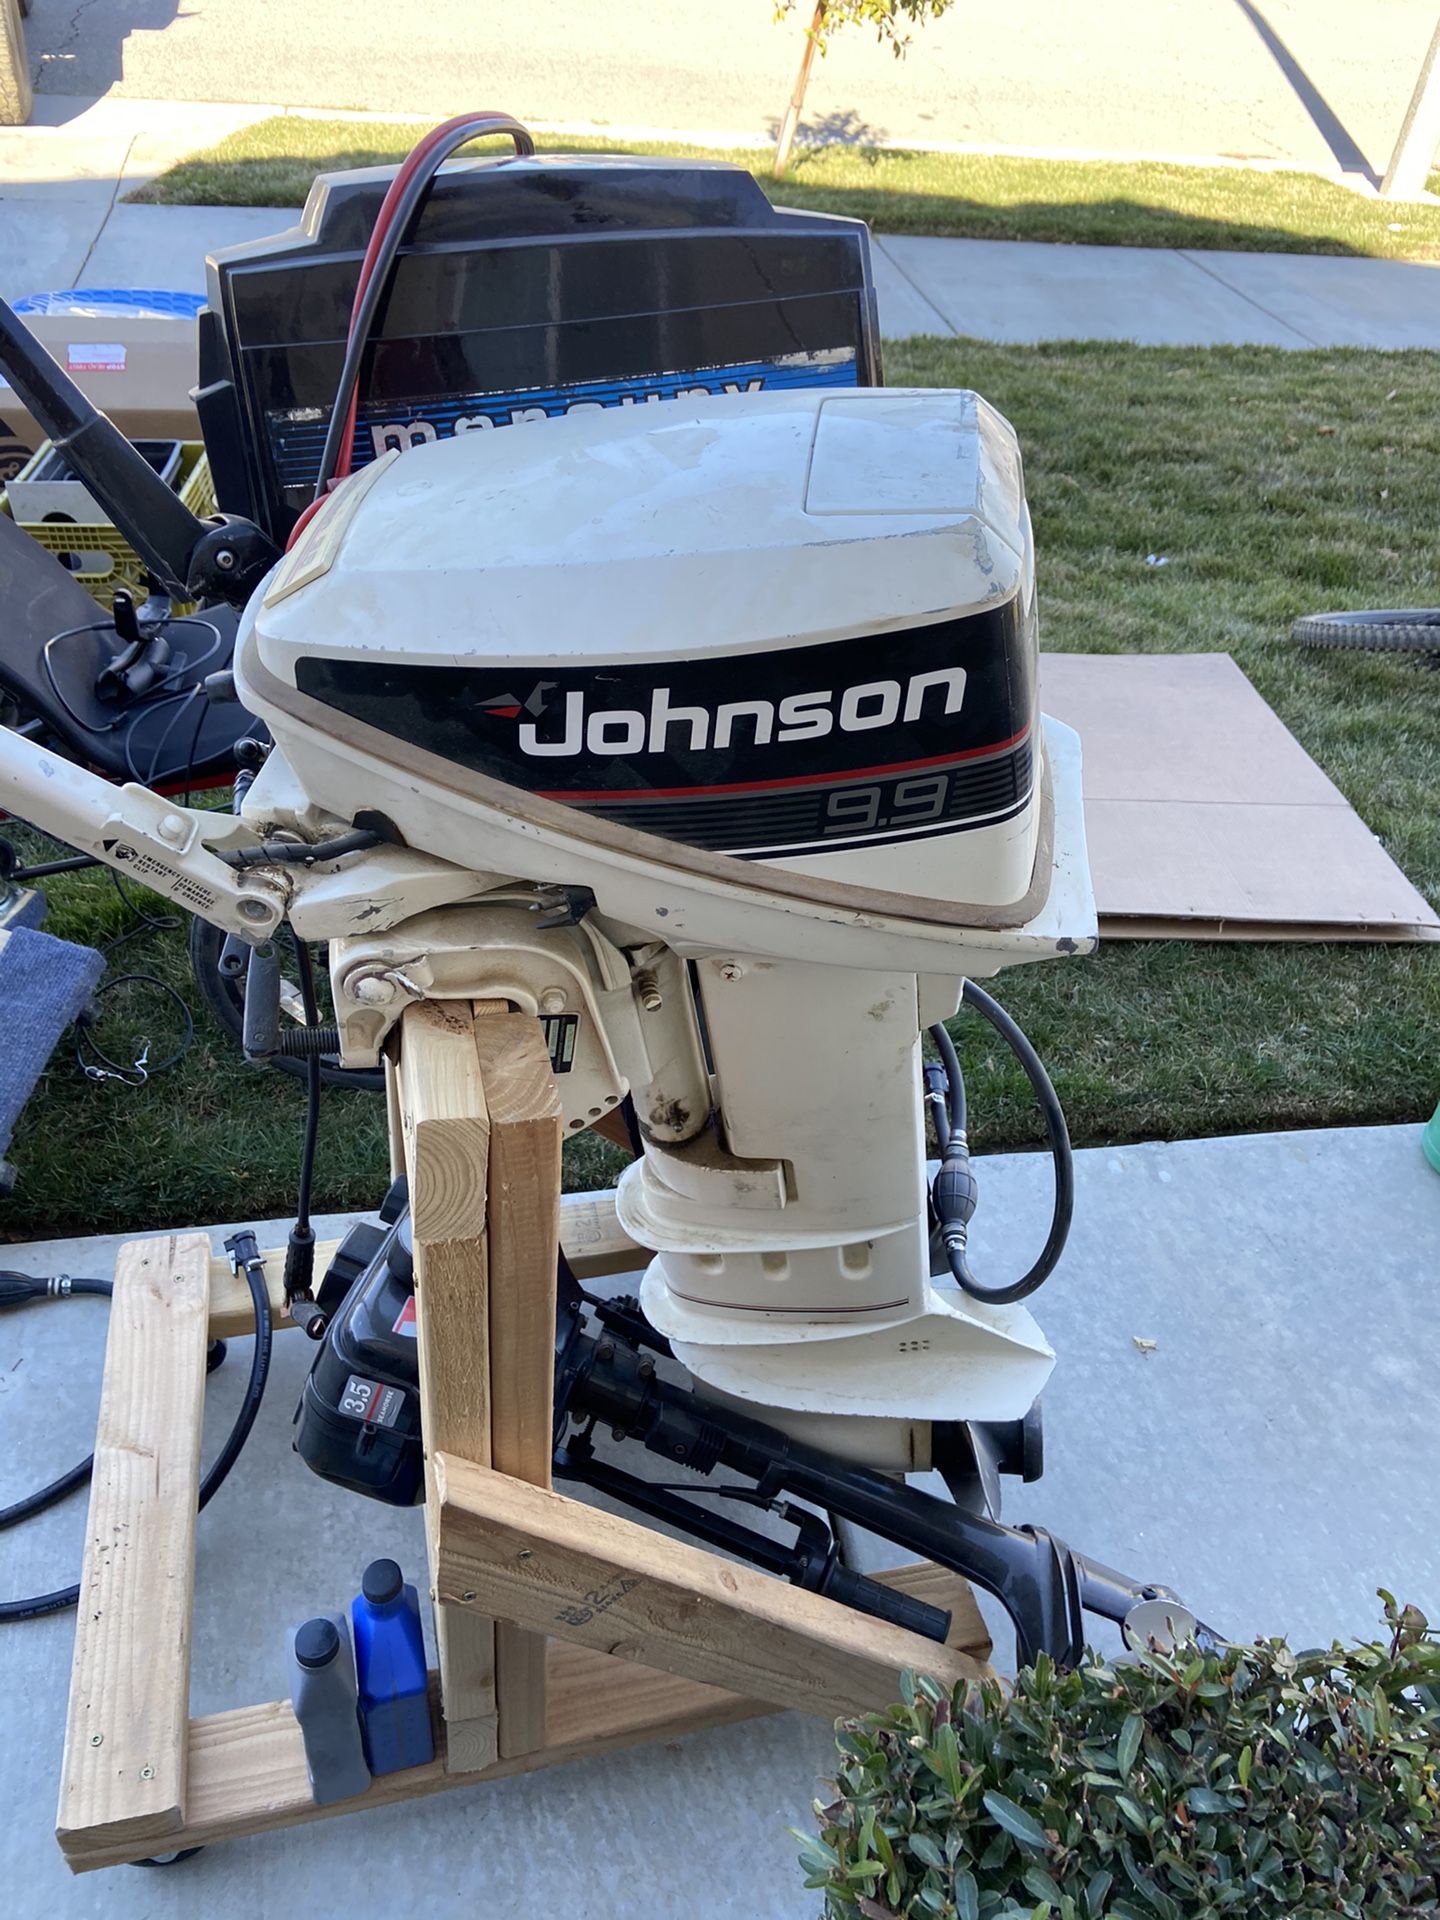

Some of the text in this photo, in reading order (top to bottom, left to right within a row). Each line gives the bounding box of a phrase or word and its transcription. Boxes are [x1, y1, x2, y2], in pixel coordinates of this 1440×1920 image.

[518, 667, 967, 757] Johnson
[822, 774, 949, 834] 9.9
[133, 863, 148, 873] CLIP
[138, 859, 168, 877] RESTART
[142, 854, 180, 878] EMERGENCY
[344, 1382, 371, 1412] 3.5
[377, 1390, 394, 1422] SEAHORSE
